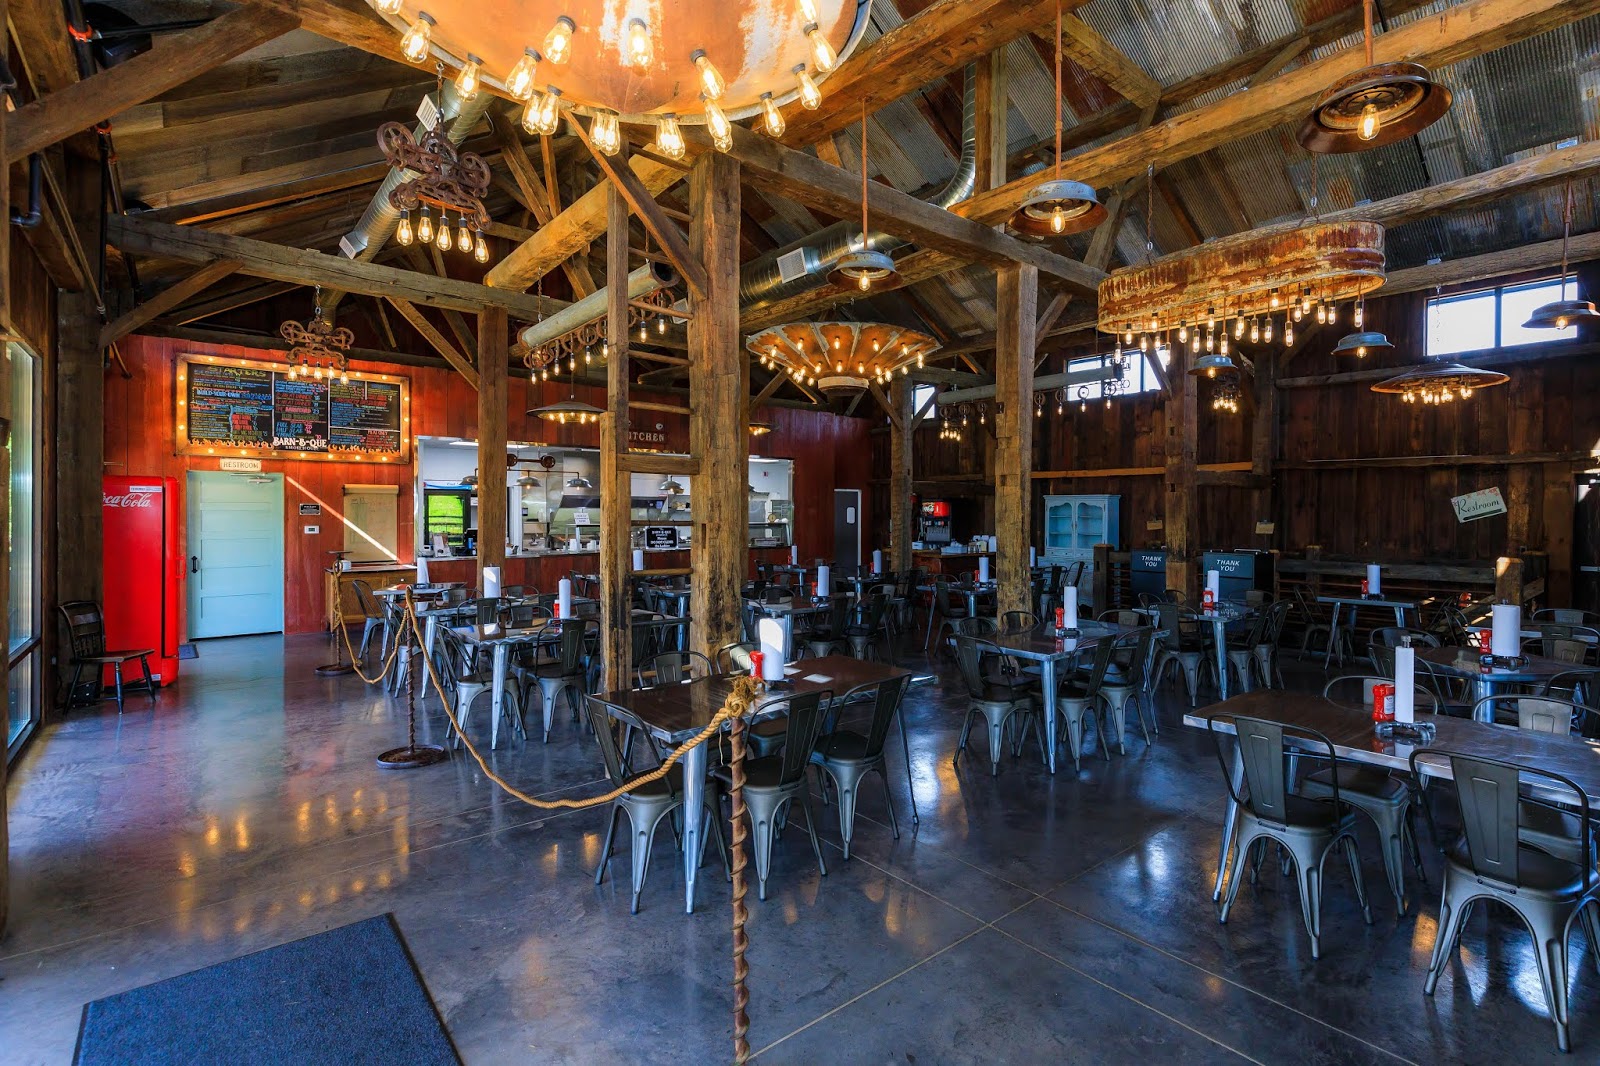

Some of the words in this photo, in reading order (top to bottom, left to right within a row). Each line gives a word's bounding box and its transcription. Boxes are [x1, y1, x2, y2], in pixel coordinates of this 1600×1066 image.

[208, 367, 266, 377] STARTERS
[629, 431, 665, 442] ITCHEN
[273, 437, 327, 448] BARN-B-QUE
[1457, 498, 1500, 515] Restroom
